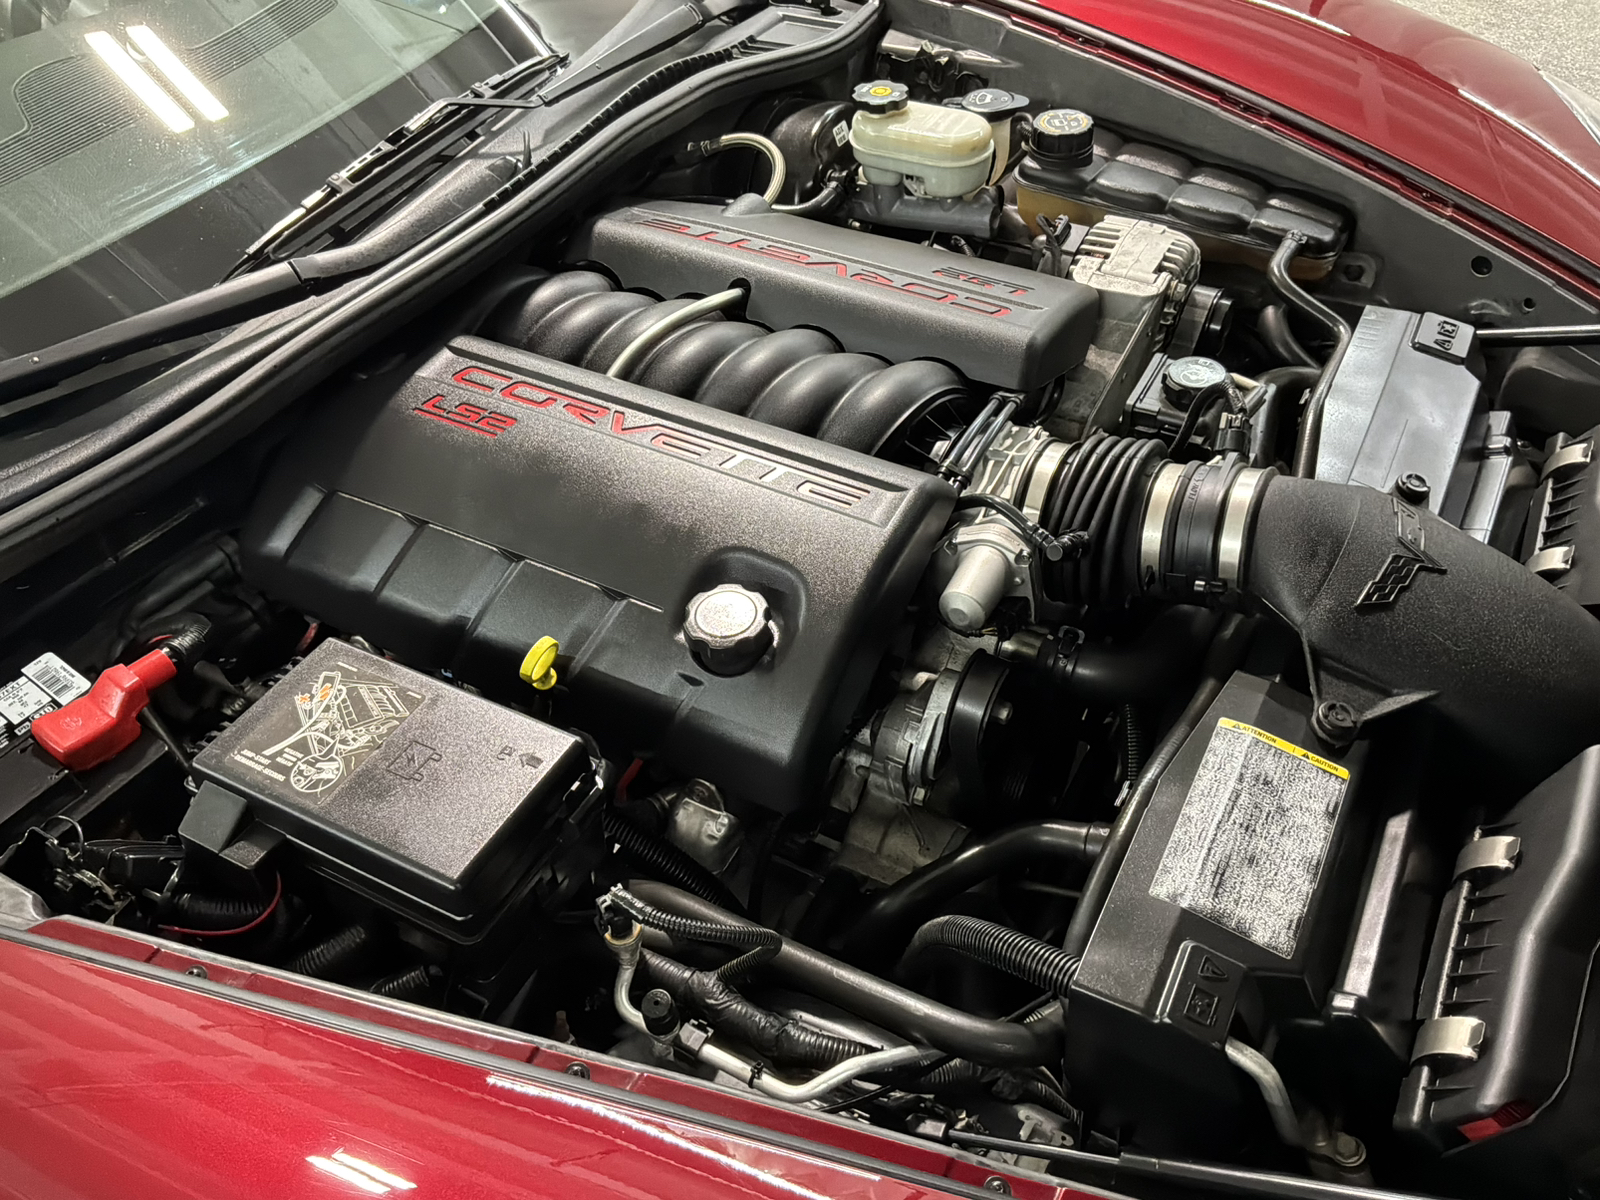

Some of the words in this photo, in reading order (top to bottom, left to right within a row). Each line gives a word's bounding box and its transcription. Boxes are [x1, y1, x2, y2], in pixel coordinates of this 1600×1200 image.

[635, 217, 1013, 318] CORVETTE
[931, 266, 1036, 297] LS2
[413, 393, 518, 439] LS2
[451, 364, 872, 510] CORVETTE
[1241, 724, 1277, 744] ATTENTION
[1310, 755, 1339, 772] CAUTION
